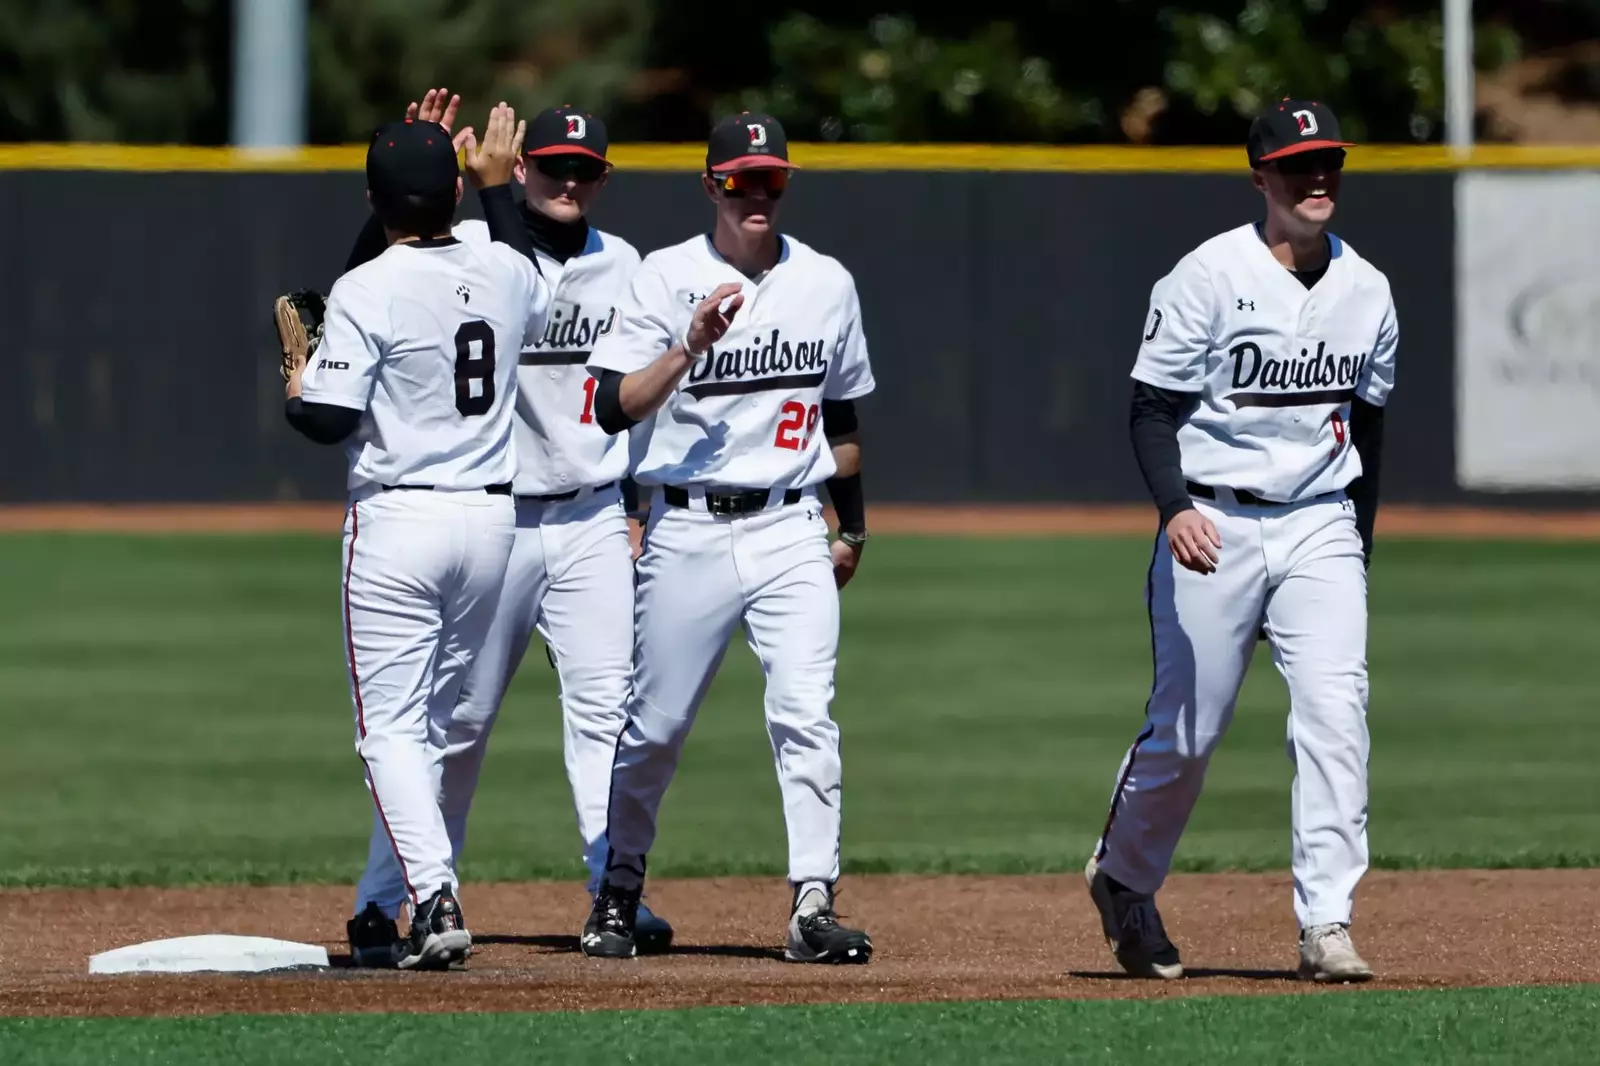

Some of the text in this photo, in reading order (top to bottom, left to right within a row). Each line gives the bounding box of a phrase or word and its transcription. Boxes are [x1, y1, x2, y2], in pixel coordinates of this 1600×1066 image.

[565, 115, 586, 140] D
[746, 123, 767, 147] D
[1292, 109, 1319, 136] D
[317, 359, 350, 372] A10
[454, 319, 496, 418] 8
[1229, 340, 1367, 391] Davidson
[774, 400, 819, 451] 29
